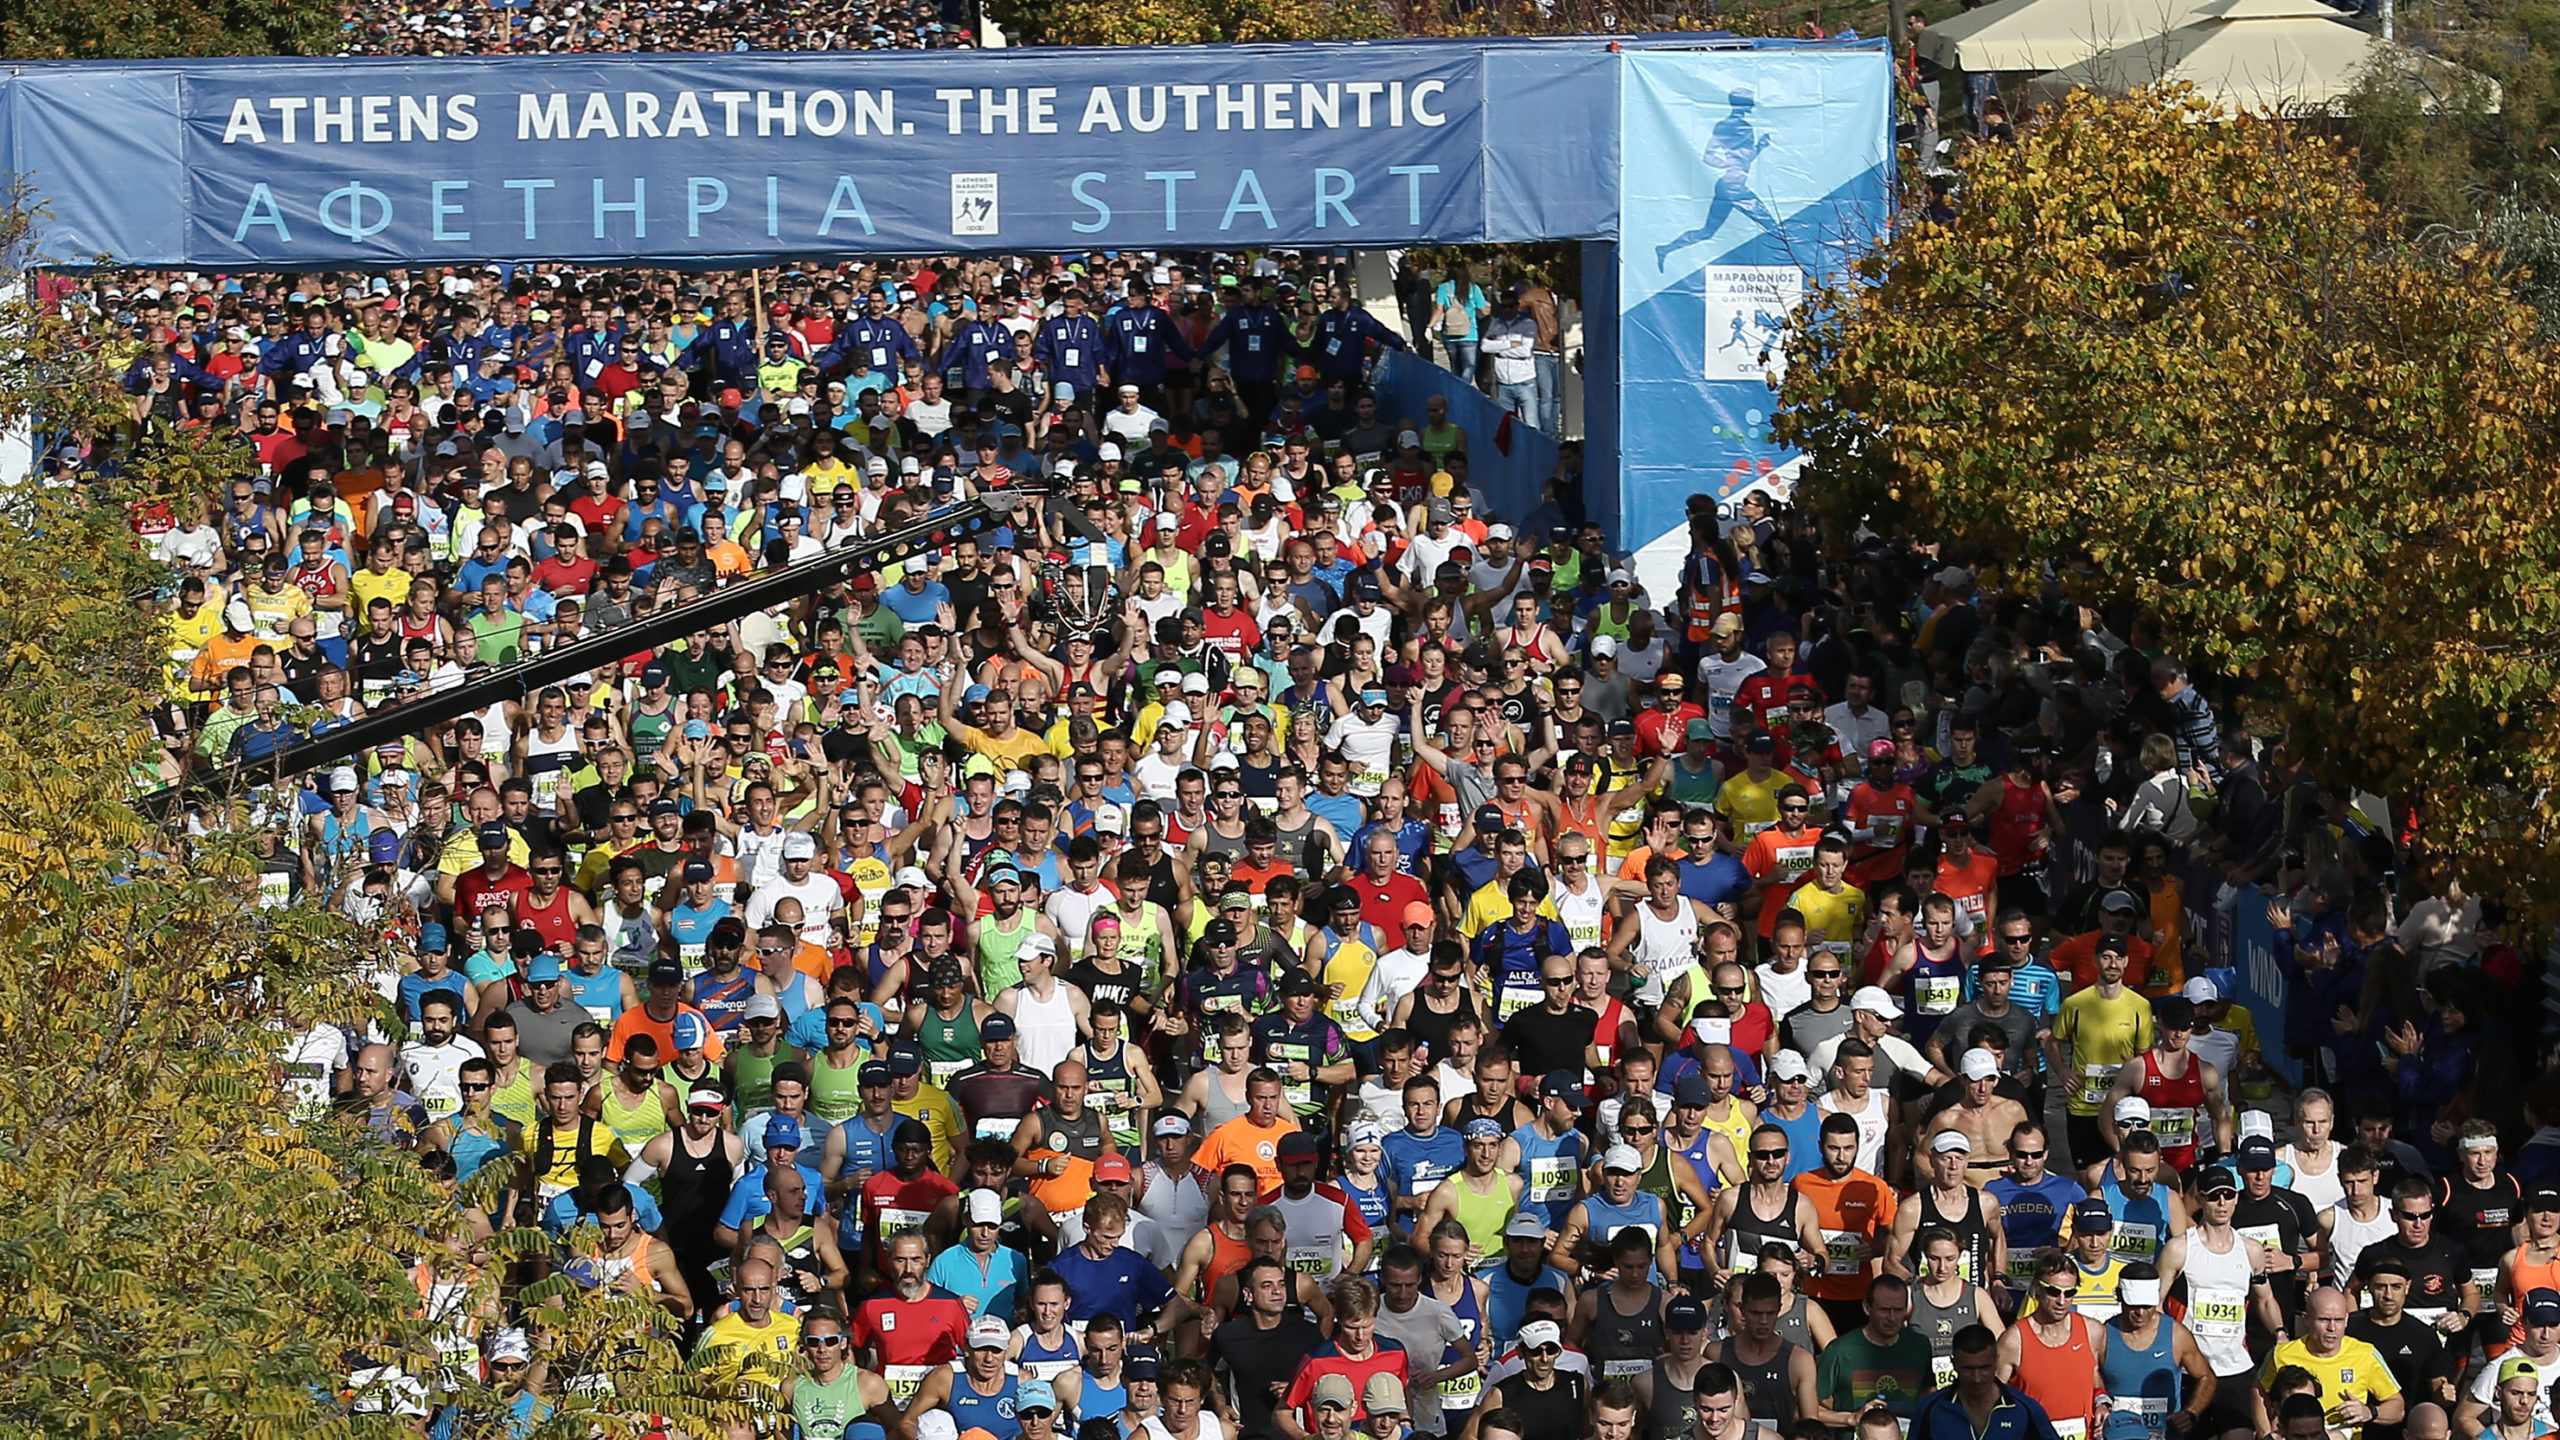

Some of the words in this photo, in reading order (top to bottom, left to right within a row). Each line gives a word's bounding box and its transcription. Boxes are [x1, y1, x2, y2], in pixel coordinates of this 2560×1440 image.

[223, 95, 479, 144] ATHENS
[517, 89, 914, 140] MARATHON.
[936, 87, 1058, 134] THE
[1078, 79, 1446, 133] AUTHENTIC
[1072, 164, 1441, 234] START
[233, 175, 876, 243] ΑΦΕΤΗΡΙΑ
[1713, 273, 1796, 283] ΜΑΡΑΘΩΝΙΟΣ
[297, 575, 327, 588] ITALIA
[1570, 926, 1594, 938] 1019
[1509, 971, 1535, 980] ALEX
[1091, 984, 1130, 1004] NIKE
[1925, 988, 1952, 1002] 1543
[422, 1098, 445, 1110] 1617
[2160, 1120, 2184, 1132] 1172
[1541, 1172, 1570, 1185] 1090
[2000, 1203, 2054, 1216] SWEDEN
[2112, 1235, 2146, 1251] 1094
[1291, 1259, 1323, 1273] 1578
[2205, 1303, 2237, 1317] 1934
[1444, 1378, 1473, 1392] 1260
